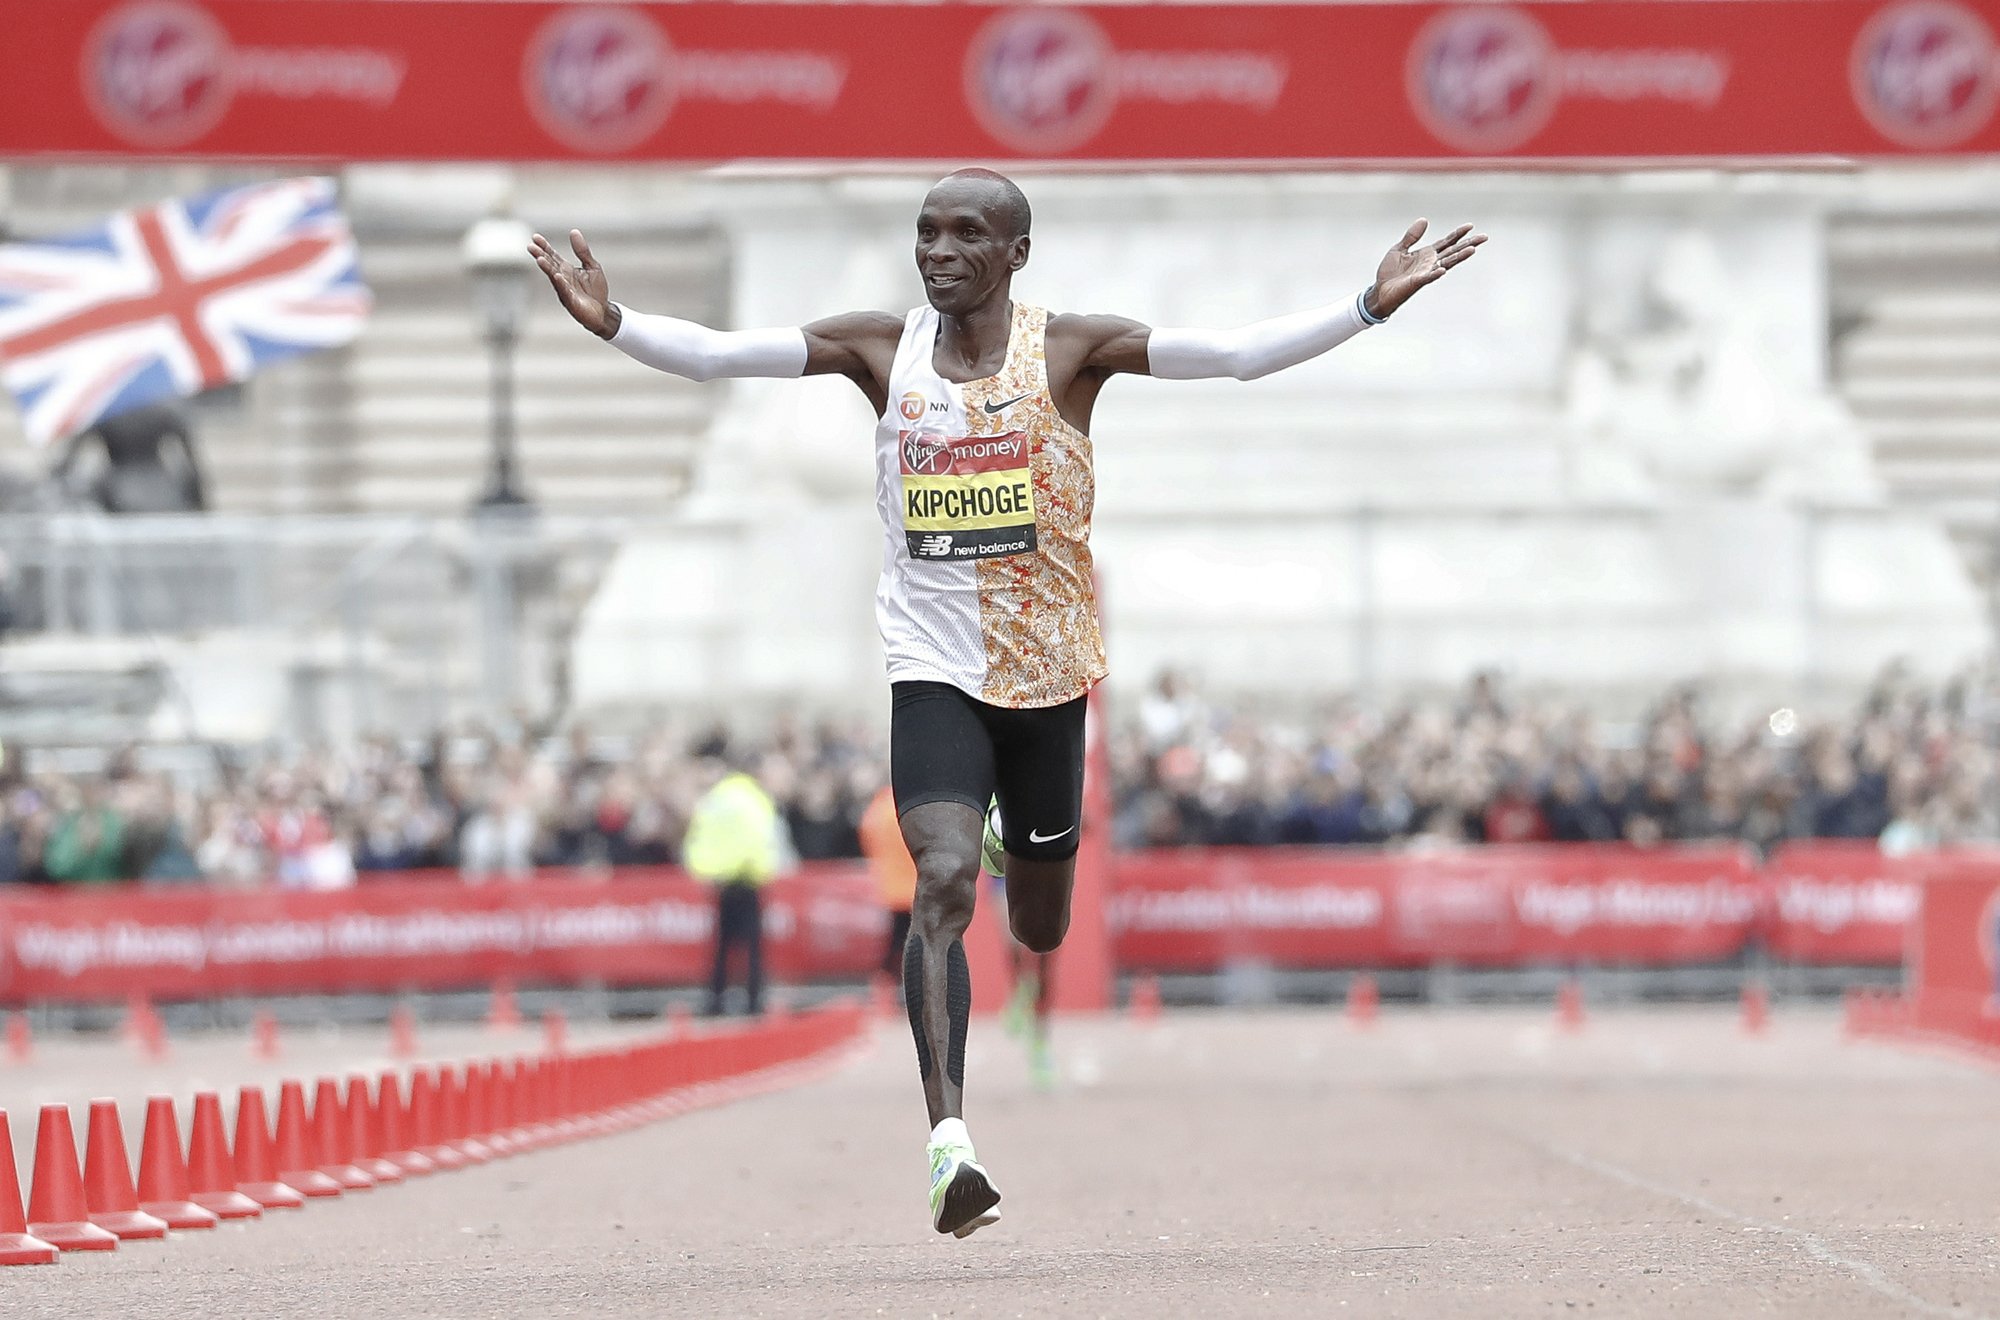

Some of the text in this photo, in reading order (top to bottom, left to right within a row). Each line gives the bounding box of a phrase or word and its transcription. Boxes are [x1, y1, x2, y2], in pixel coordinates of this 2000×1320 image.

[929, 402, 949, 412] NN
[954, 440, 1021, 459] money
[908, 484, 1028, 518] KIPCHOGE
[954, 547, 977, 556] new
